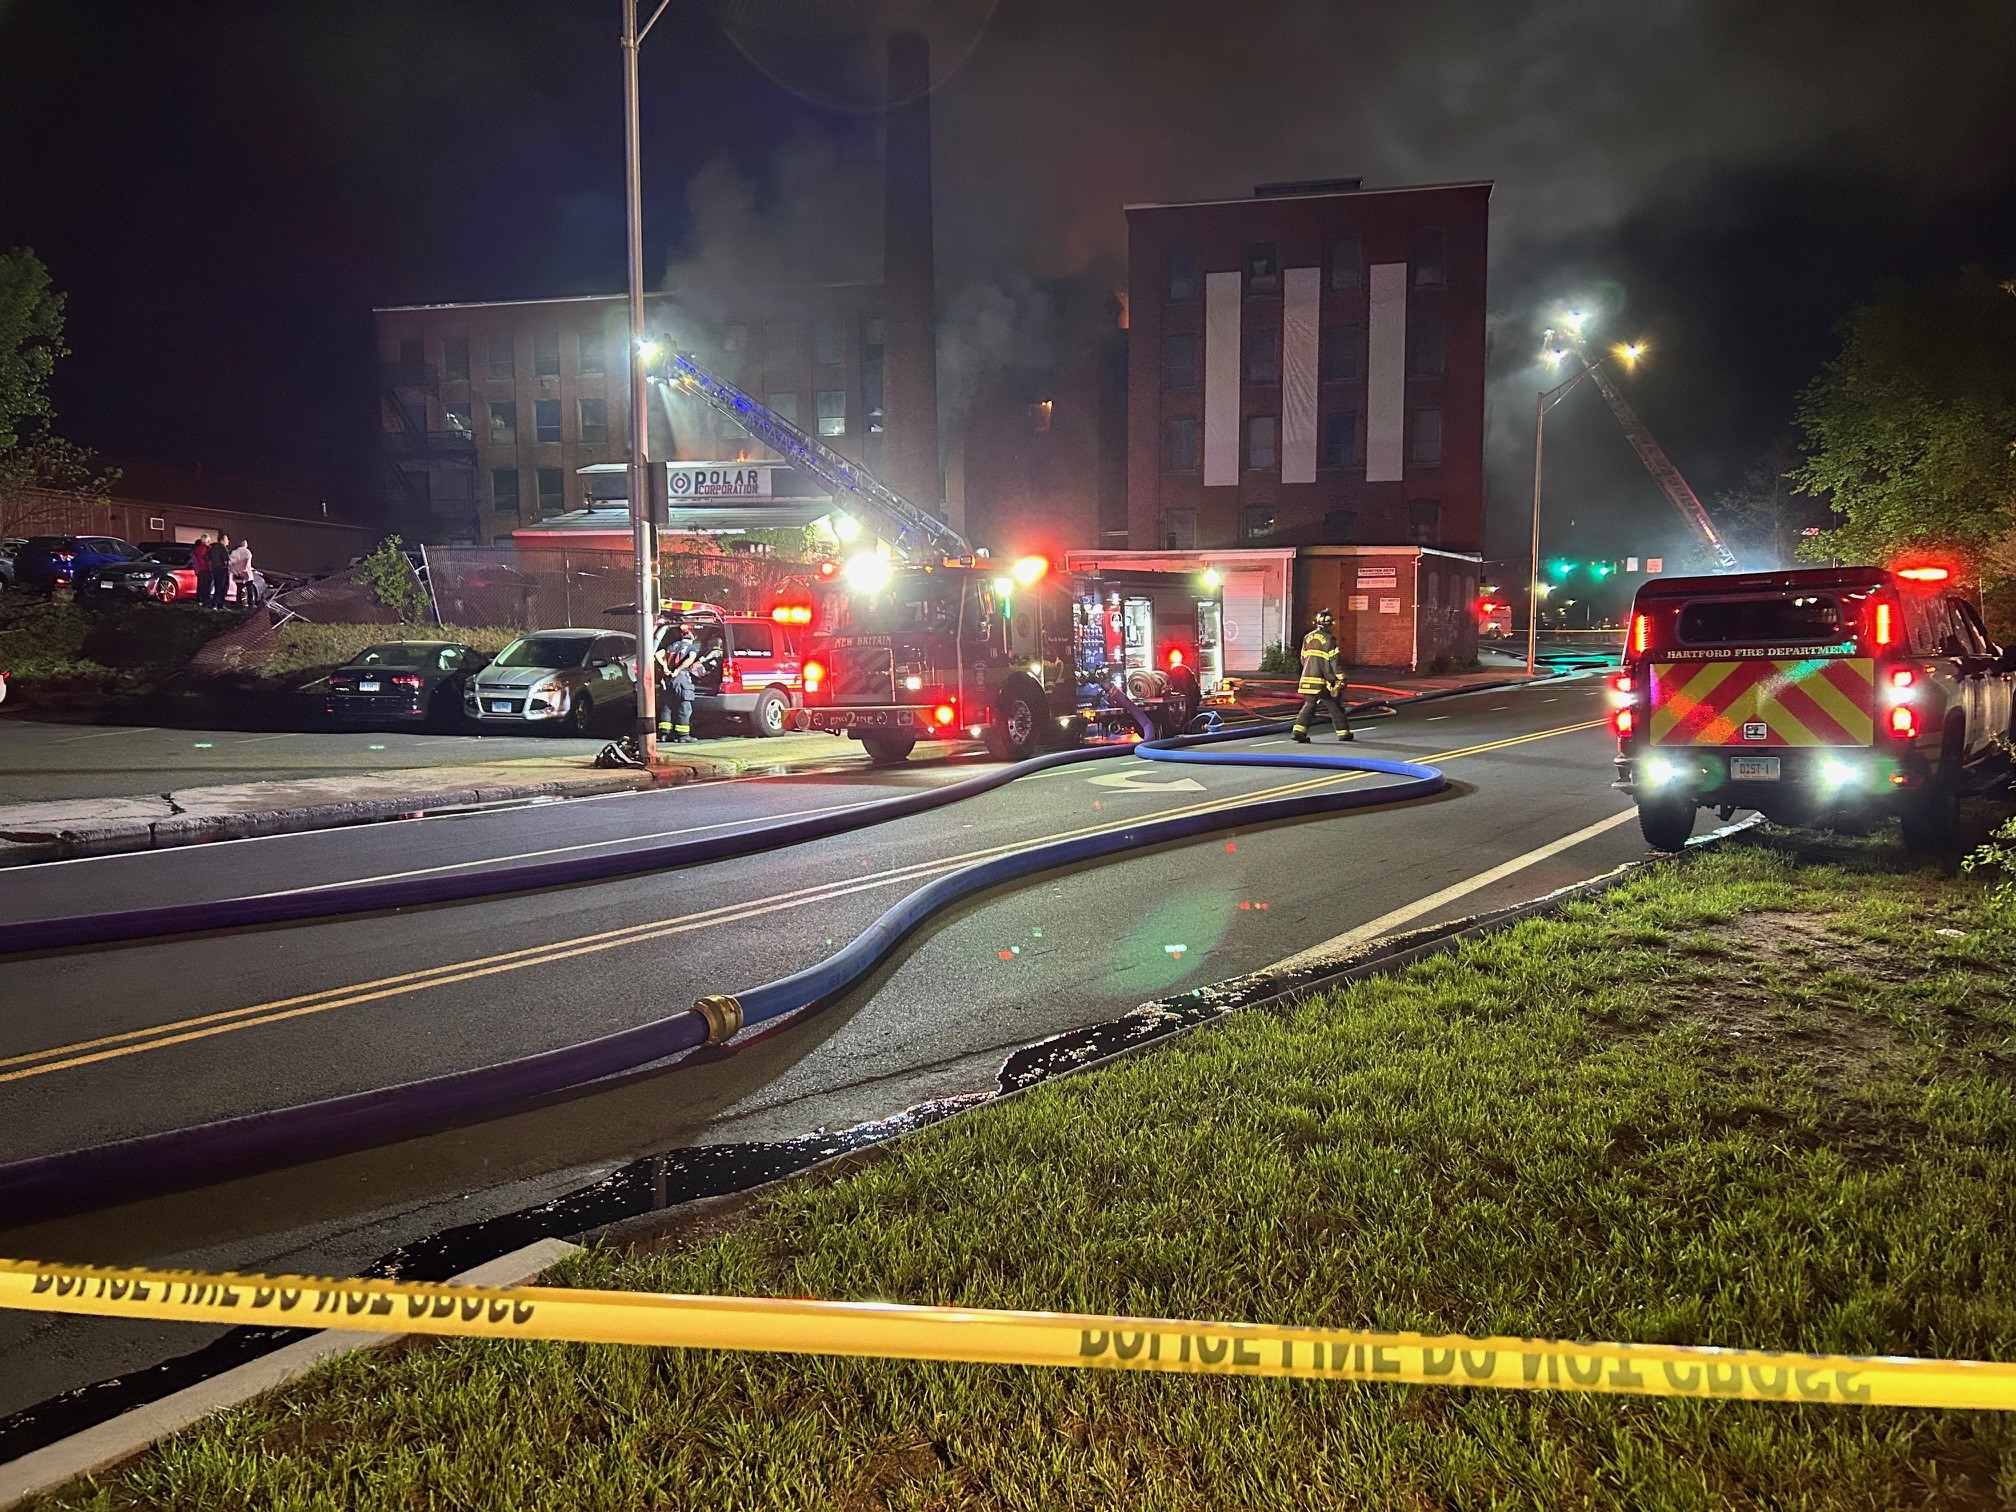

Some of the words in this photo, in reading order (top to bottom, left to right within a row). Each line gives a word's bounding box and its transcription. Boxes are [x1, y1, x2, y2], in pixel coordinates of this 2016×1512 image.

[694, 470, 758, 494] POLAR
[699, 484, 759, 495] CORPORATION
[834, 637, 853, 648] NEW
[857, 635, 892, 646] BRITAIN
[1667, 649, 1731, 659] HARTFORD
[1734, 648, 1764, 657] FIRE
[1767, 644, 1857, 656] DEPARTMENT
[1740, 763, 1769, 775] DIST-1
